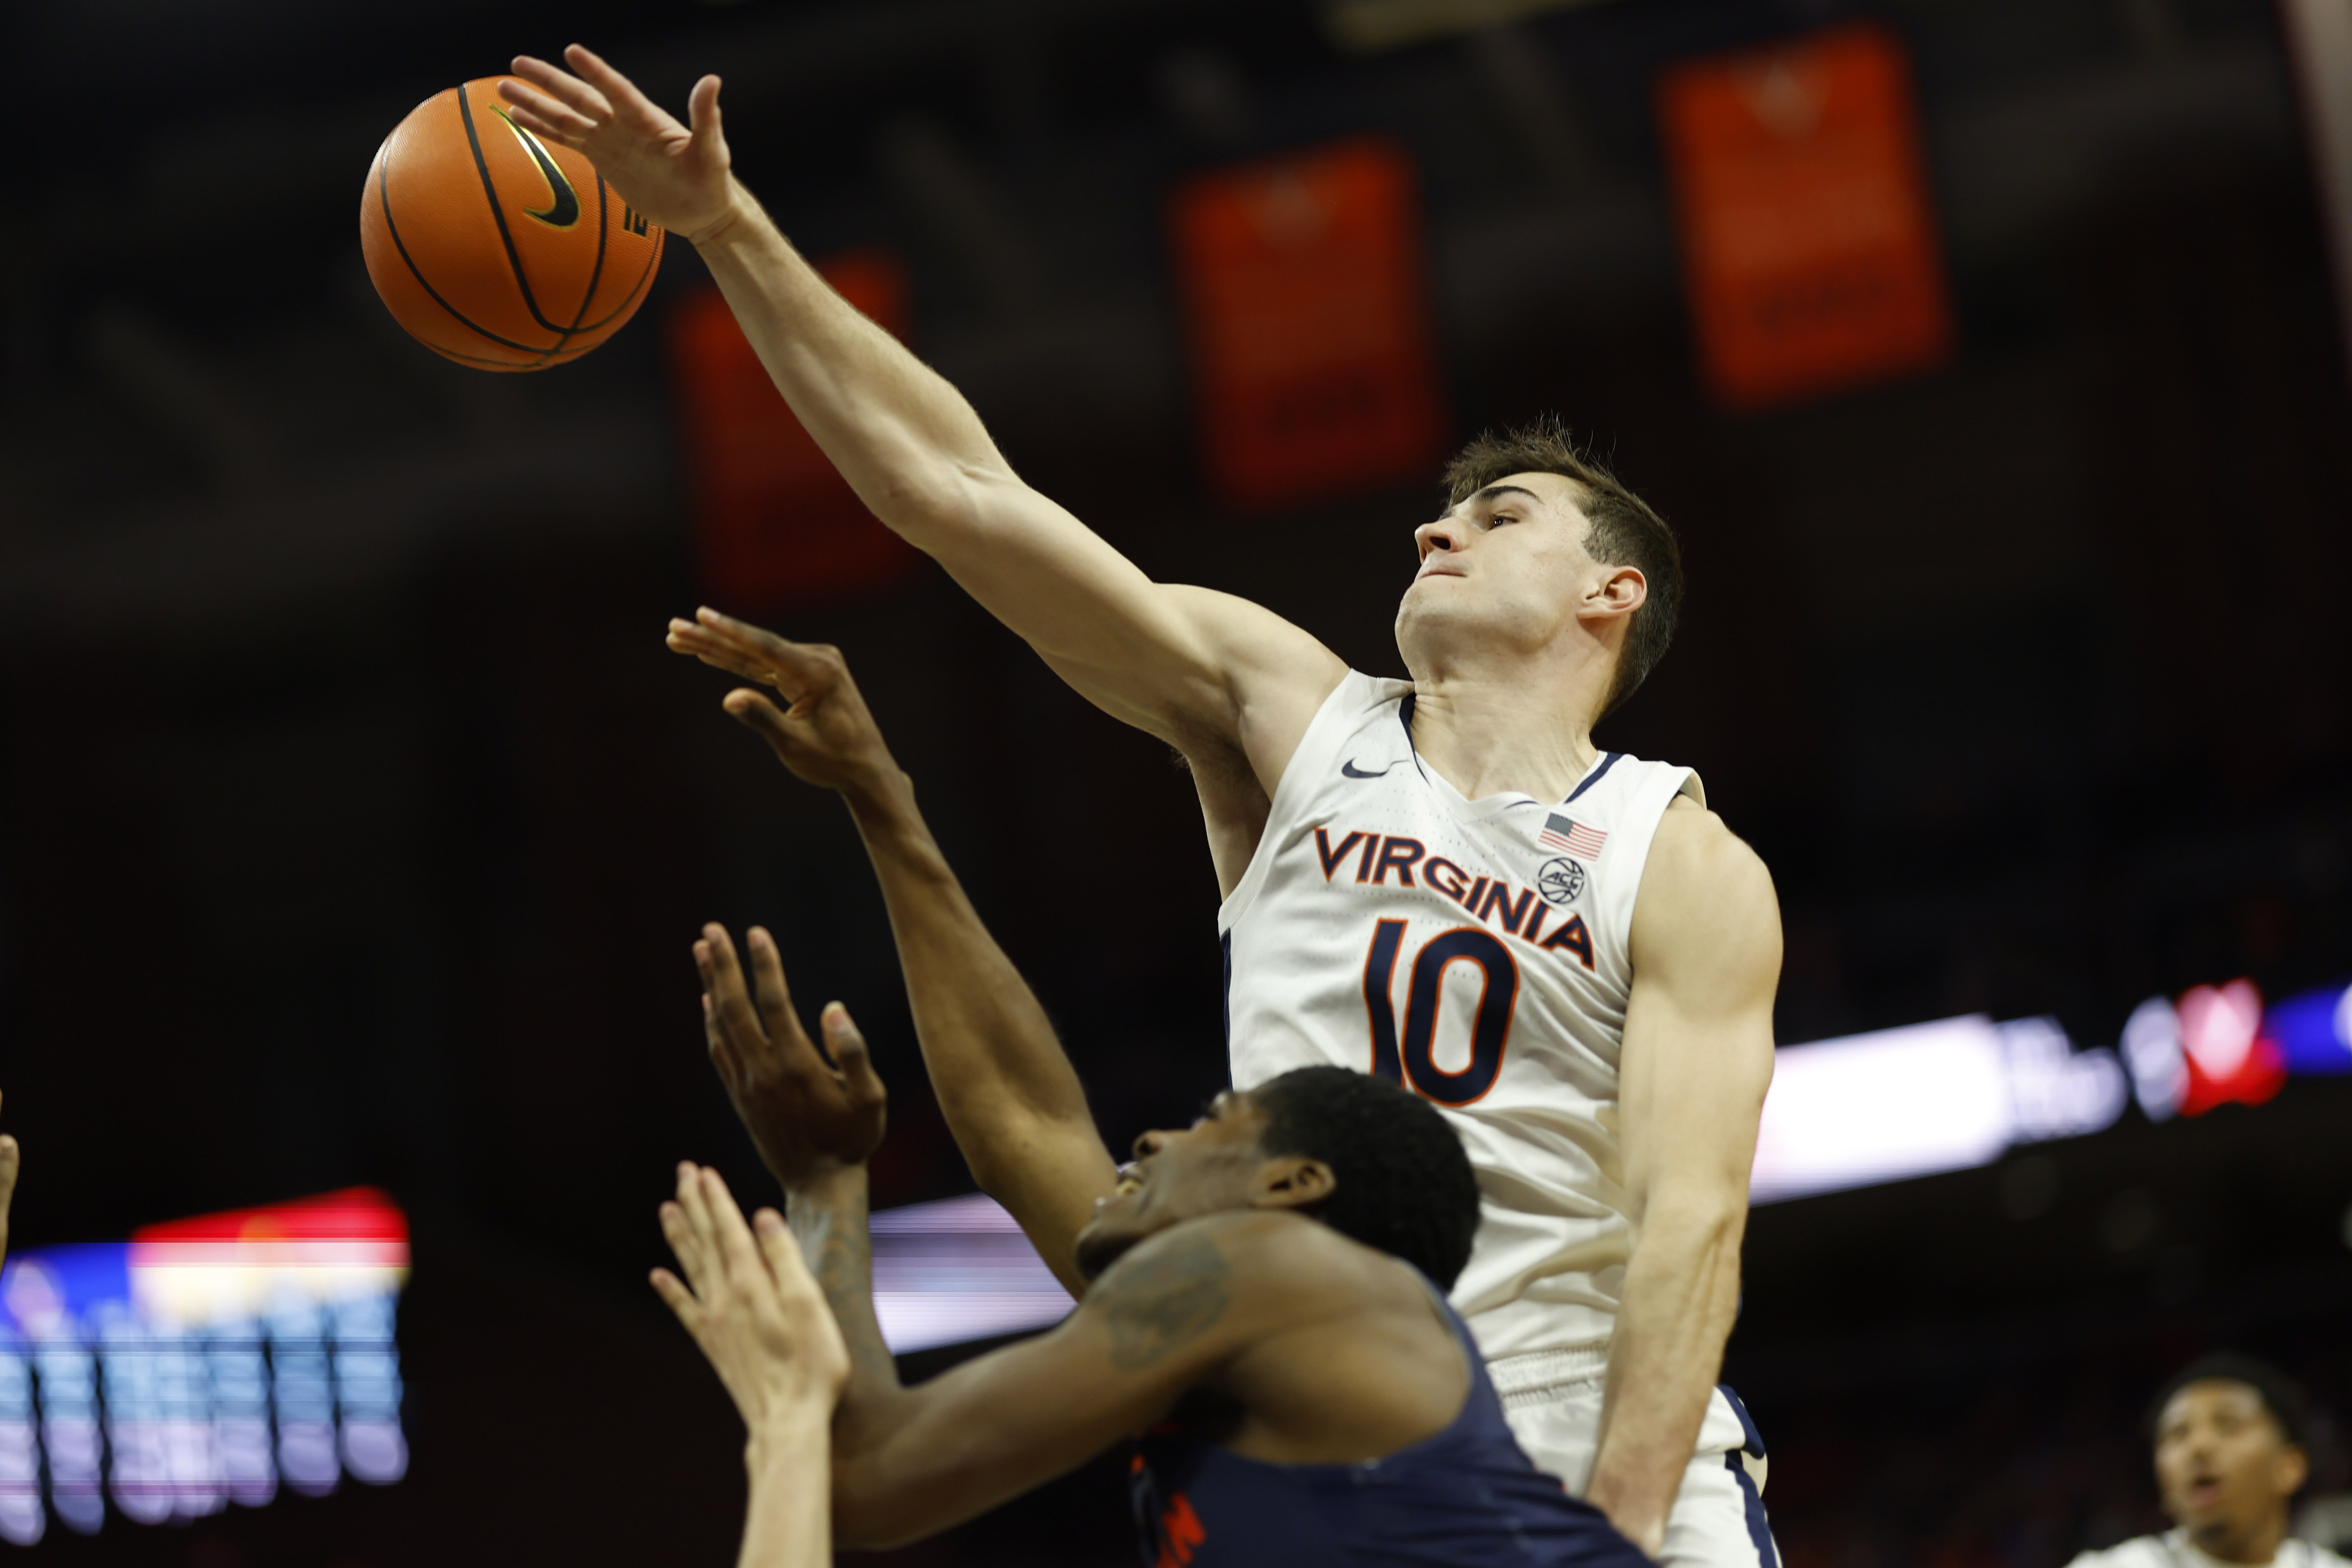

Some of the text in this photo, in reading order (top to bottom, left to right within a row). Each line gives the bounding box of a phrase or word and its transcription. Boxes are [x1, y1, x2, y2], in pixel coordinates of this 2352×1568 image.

[1314, 827, 1596, 972] VIRGINIA
[1545, 872, 1583, 890] ACC
[1363, 918, 1520, 1107] 10
